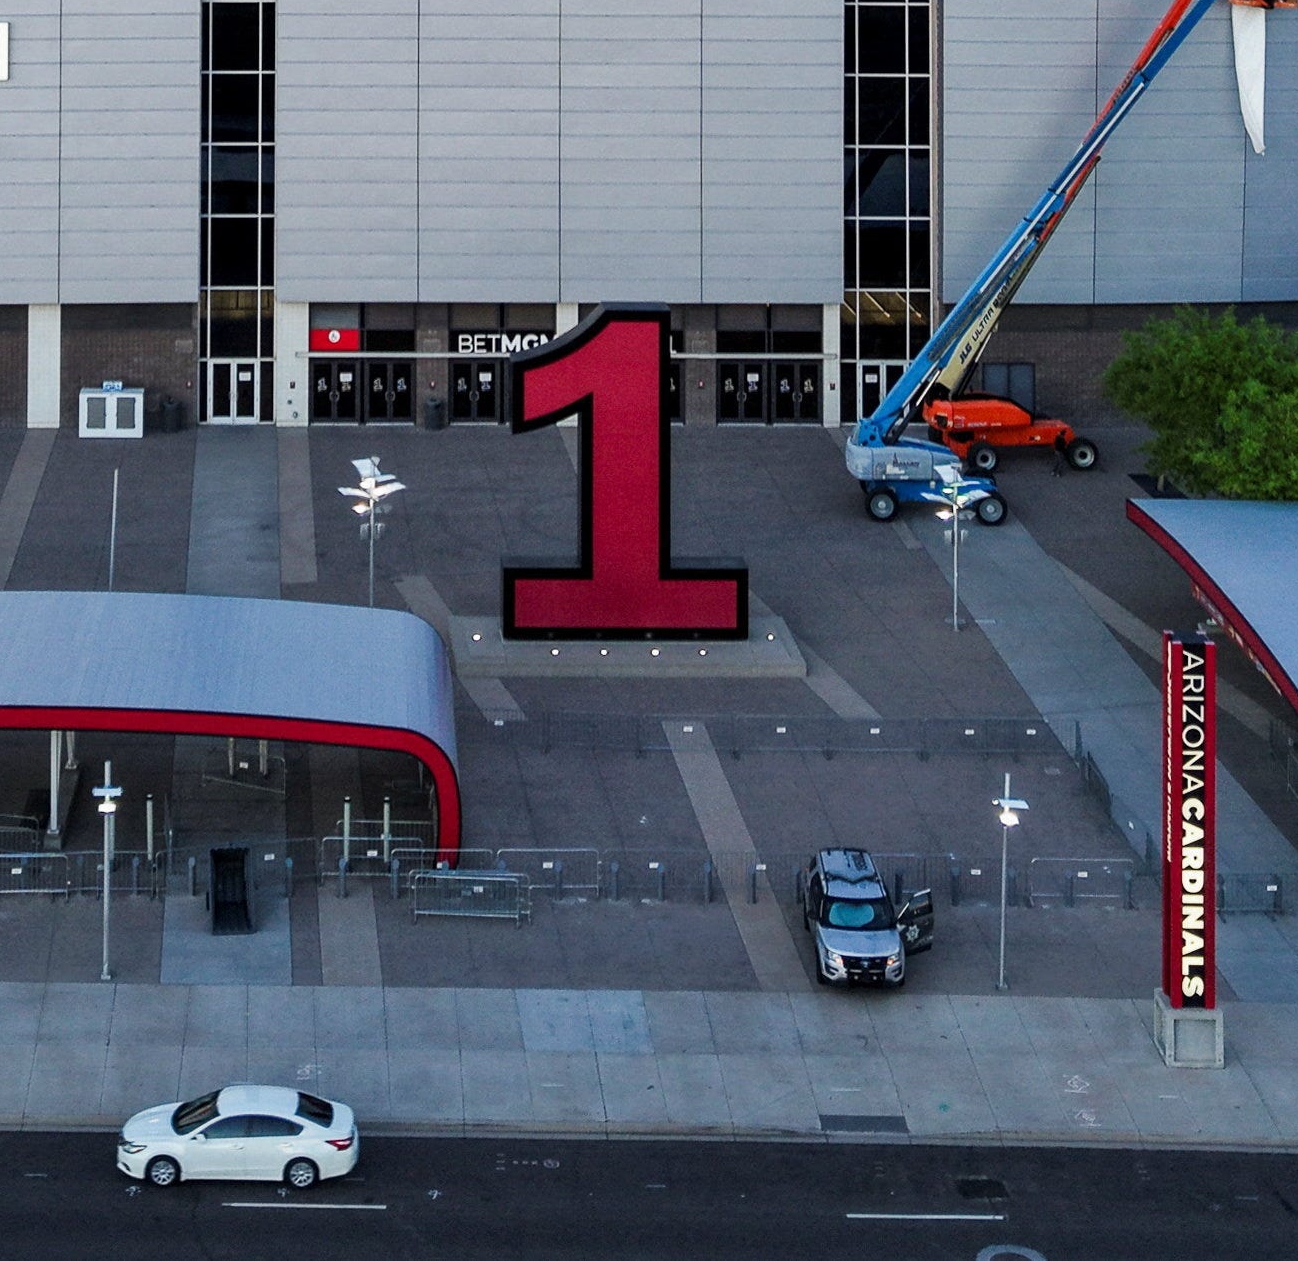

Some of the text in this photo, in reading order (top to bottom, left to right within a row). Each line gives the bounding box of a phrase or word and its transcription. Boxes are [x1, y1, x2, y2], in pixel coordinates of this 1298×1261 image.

[458, 334, 559, 354] BETMG
[959, 342, 973, 364] JLG
[972, 308, 994, 342] ULTRA
[503, 301, 749, 641] 1
[1182, 650, 1205, 794] ARIZONA
[1182, 797, 1205, 998] CARDINALS
